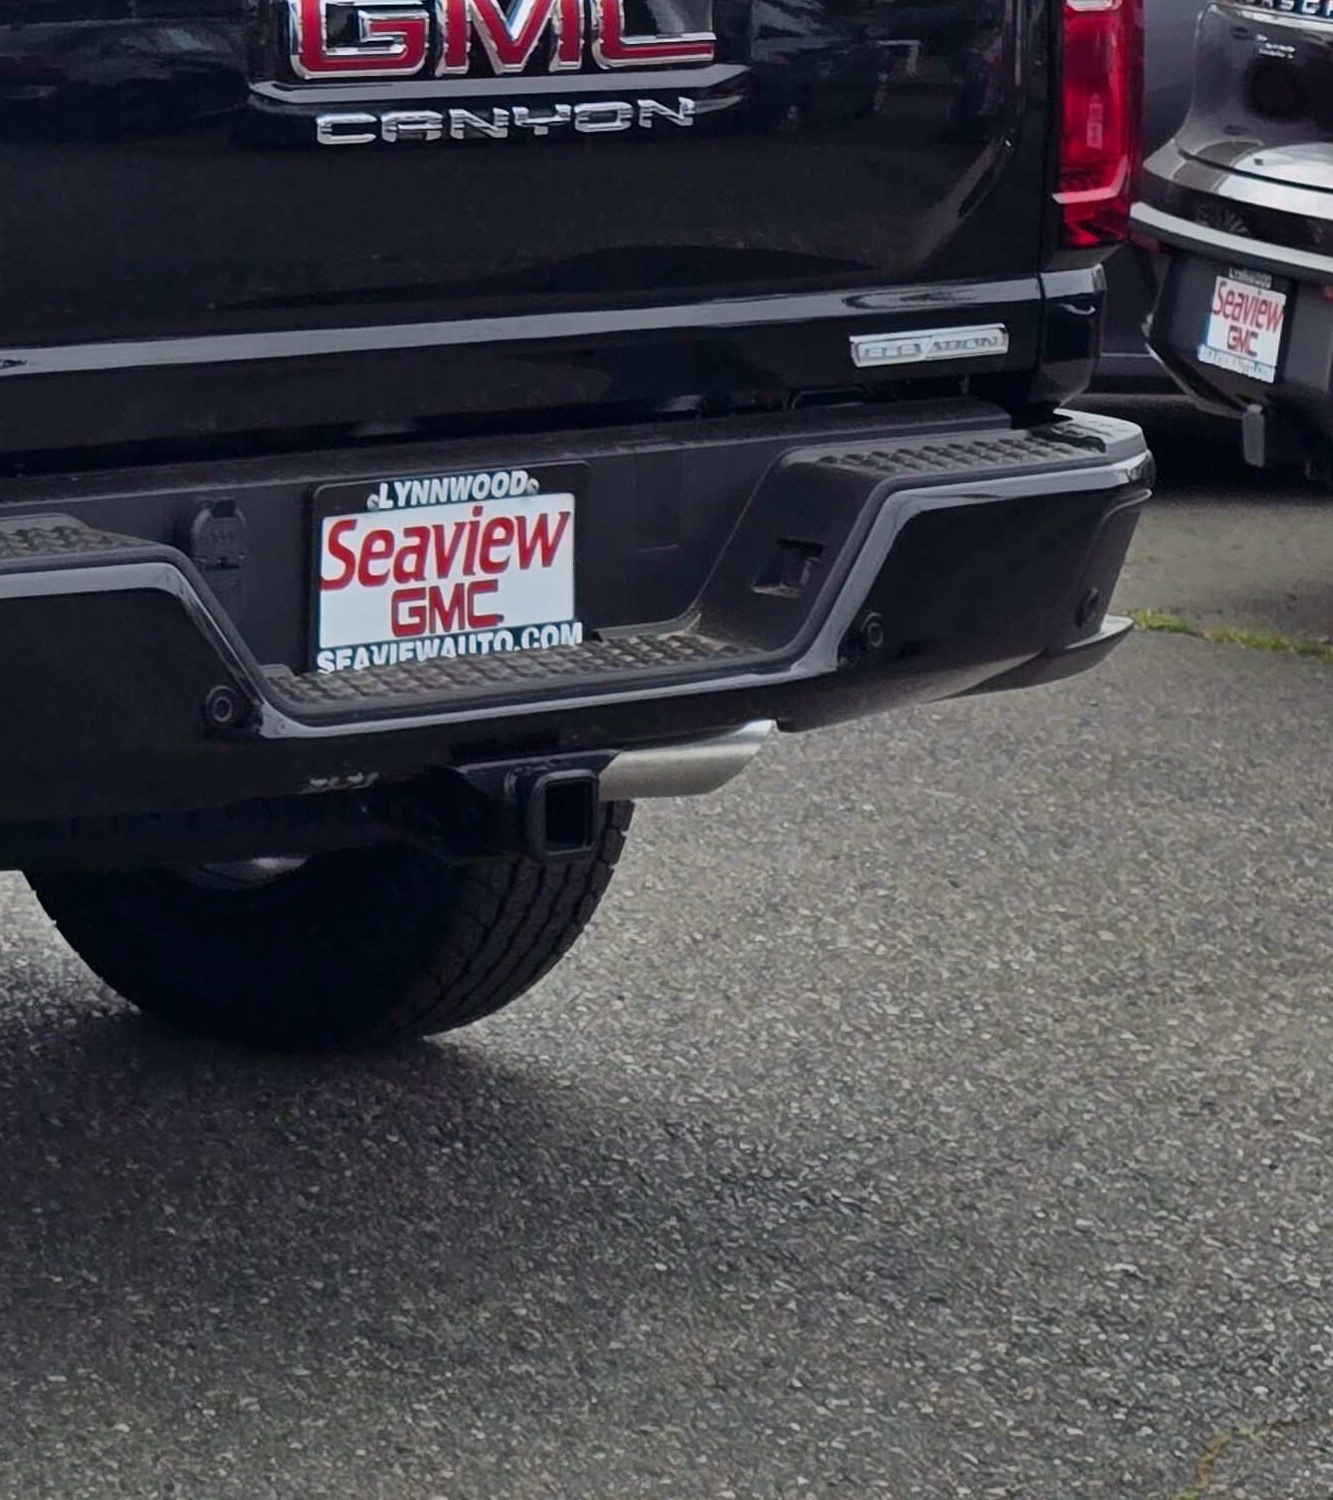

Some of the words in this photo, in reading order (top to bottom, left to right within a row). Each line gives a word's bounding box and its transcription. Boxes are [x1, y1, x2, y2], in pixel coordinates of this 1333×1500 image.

[316, 96, 695, 145] CANYON
[1213, 280, 1284, 333] Seaview
[1227, 325, 1259, 358] GMC
[378, 470, 529, 509] LYNNWOOD
[319, 505, 571, 591] Seaview
[391, 579, 503, 638] GMC
[317, 621, 583, 675] SEAVIEWAUTO.COM
